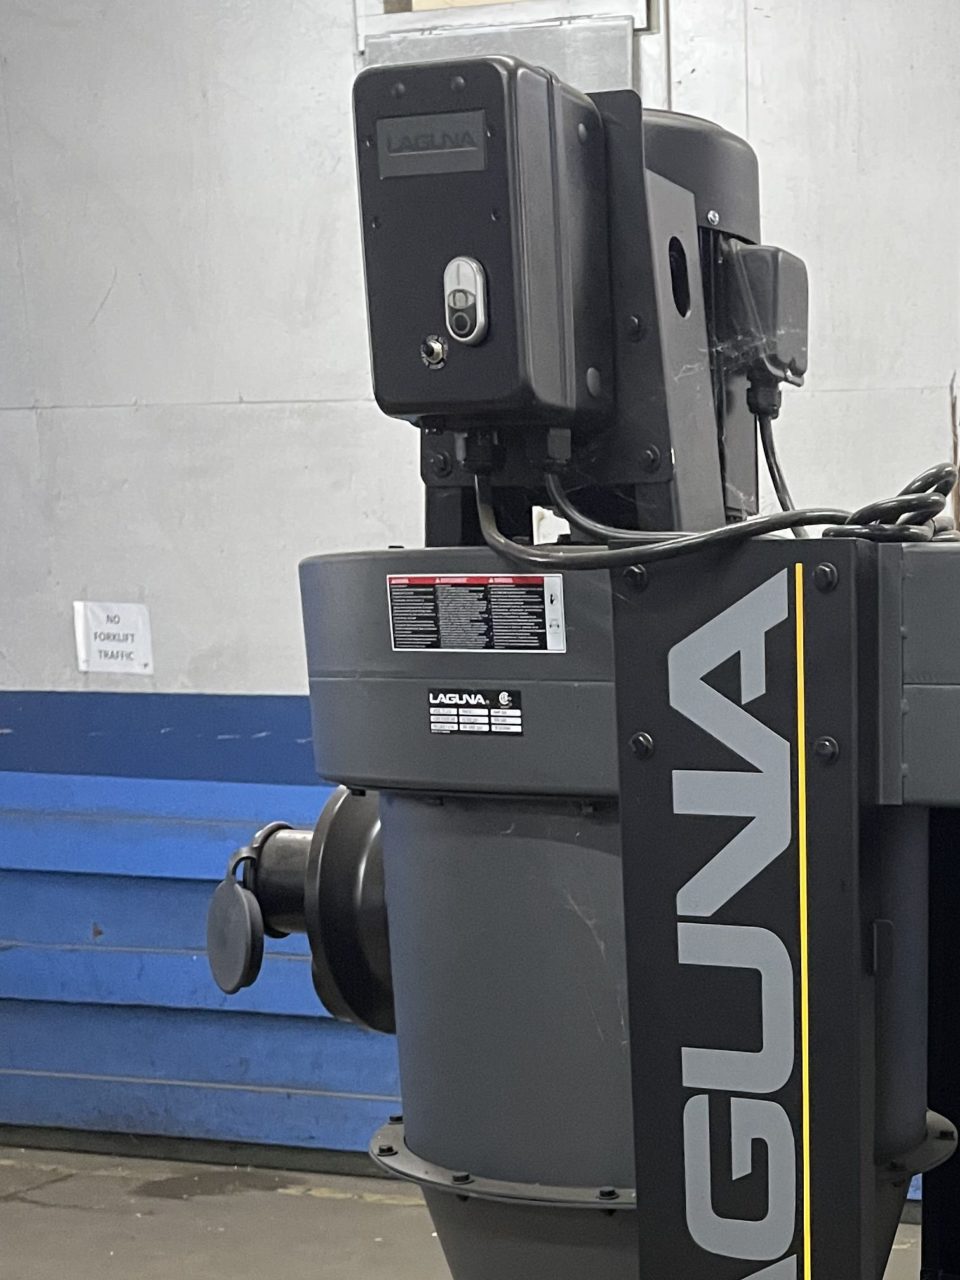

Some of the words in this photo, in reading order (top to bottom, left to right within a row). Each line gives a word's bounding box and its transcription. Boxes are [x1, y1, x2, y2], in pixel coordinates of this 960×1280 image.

[386, 130, 477, 154] LAGUNA
[106, 614, 121, 625] NO
[93, 632, 135, 643] FORKLIFT
[98, 649, 135, 661] TRAFFIC
[429, 693, 486, 705] LAGUNA
